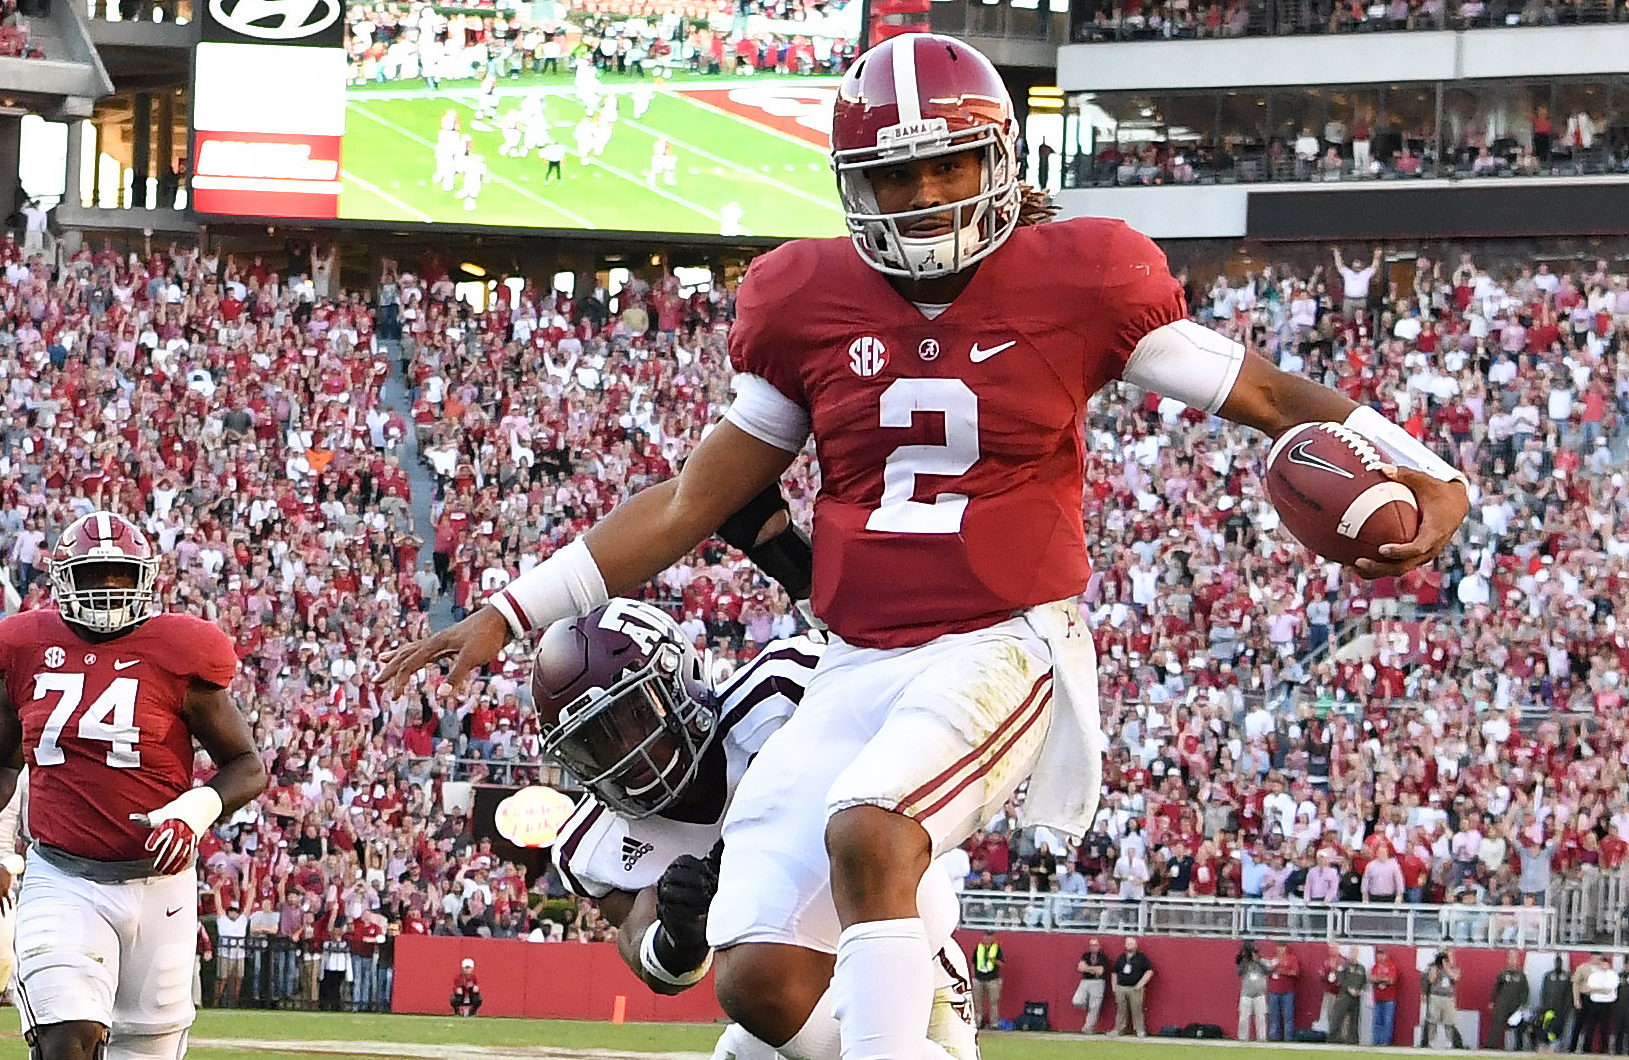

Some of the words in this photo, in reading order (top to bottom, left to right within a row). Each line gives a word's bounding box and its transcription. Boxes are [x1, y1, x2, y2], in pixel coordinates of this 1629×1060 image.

[895, 123, 928, 138] BAMA
[848, 335, 886, 377] SEC
[865, 378, 980, 534] 2
[33, 672, 140, 768] 74
[623, 843, 655, 872] adidas
